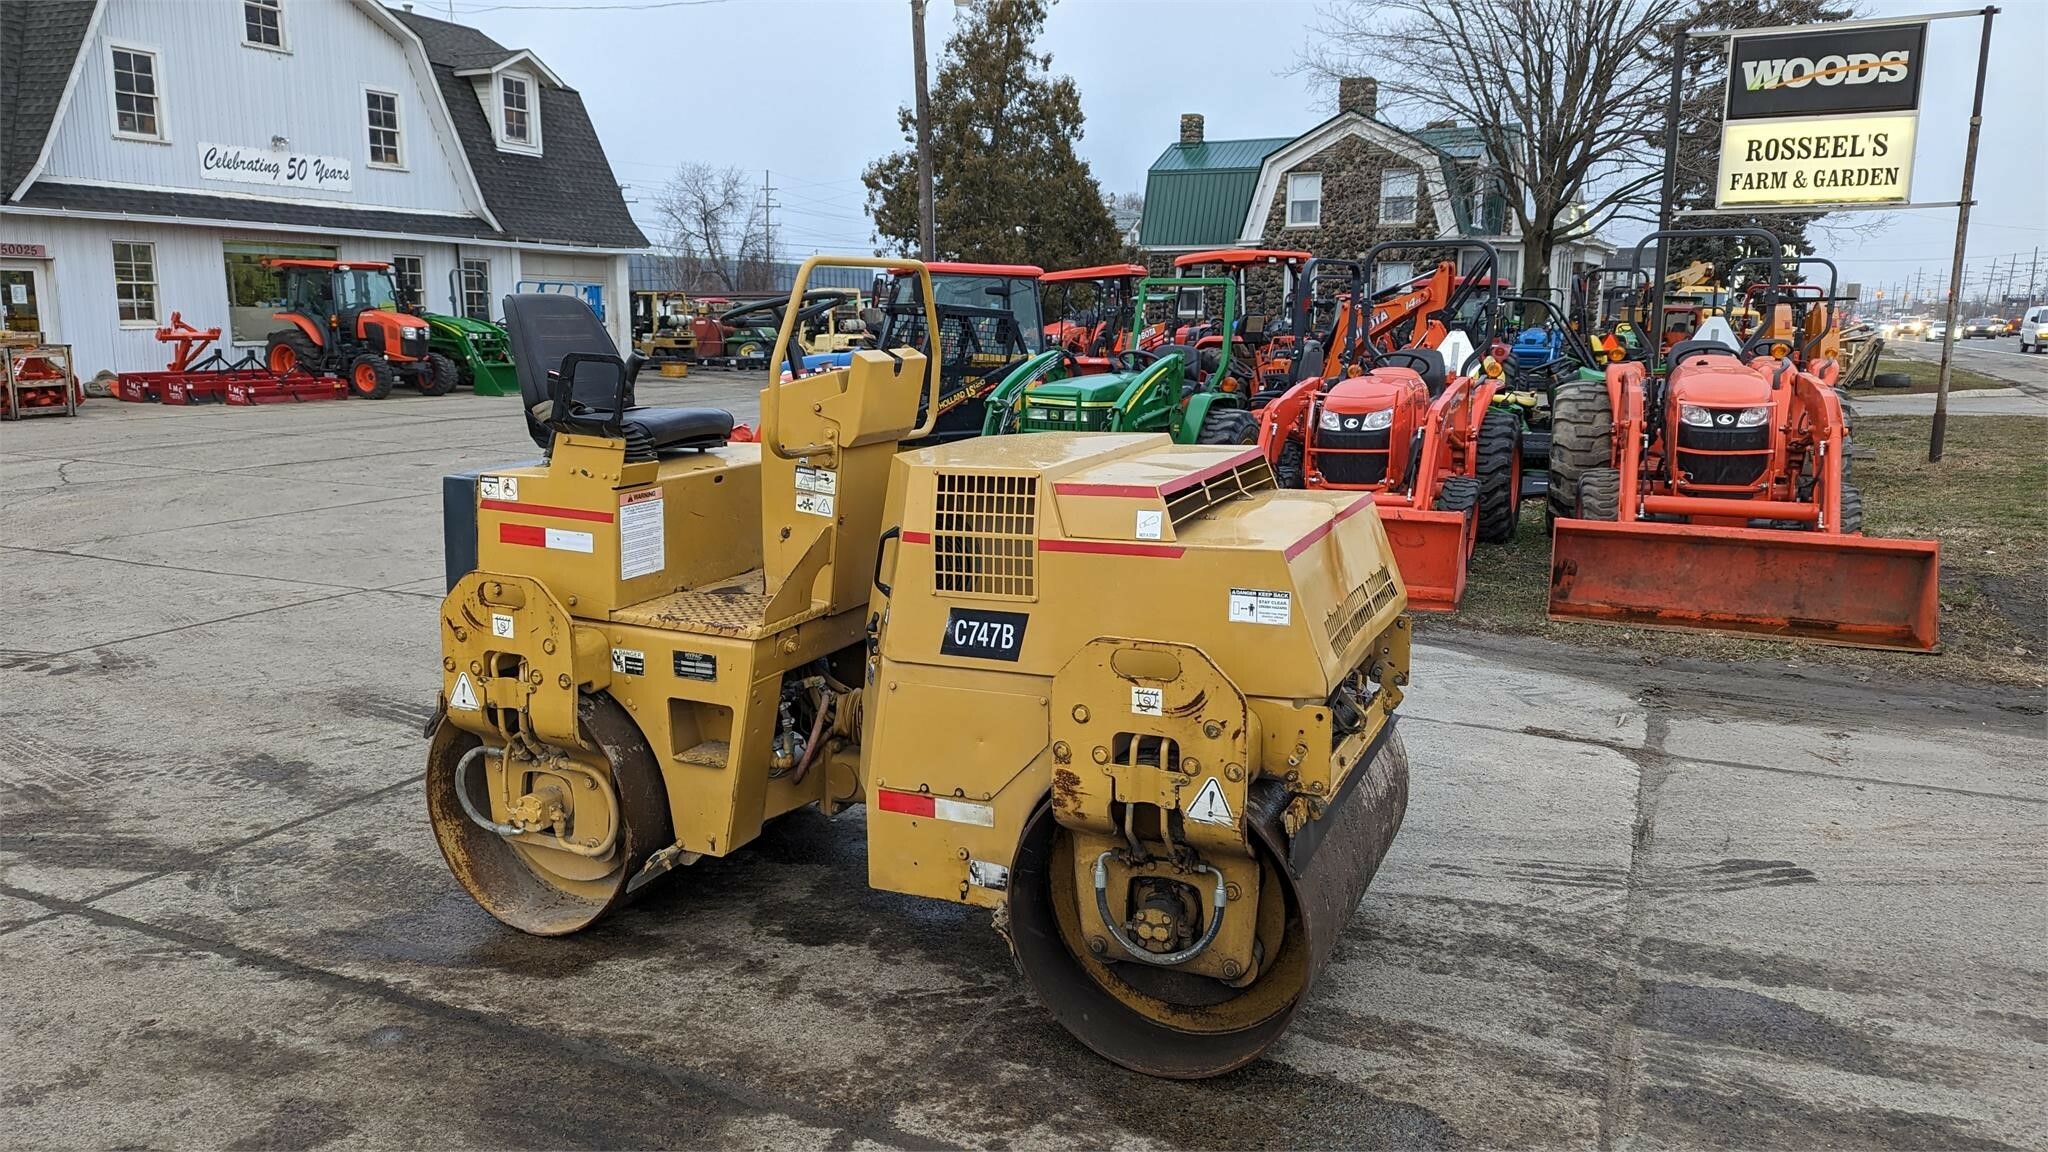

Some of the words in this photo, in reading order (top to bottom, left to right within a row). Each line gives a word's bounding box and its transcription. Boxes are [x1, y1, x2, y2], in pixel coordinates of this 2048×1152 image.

[1742, 51, 1909, 91] WOODS
[1745, 133, 1889, 161] ROSSEEL'S
[203, 147, 280, 180] Celebrating
[287, 157, 307, 180] 50
[313, 159, 350, 184] Years
[1729, 171, 1787, 190] FARM
[1792, 170, 1808, 188] &
[1813, 167, 1899, 187] GARDEN
[1, 244, 38, 255] 50025
[939, 391, 965, 409] HOLLAND
[633, 490, 656, 500] WARNING
[955, 620, 1014, 649] C747B
